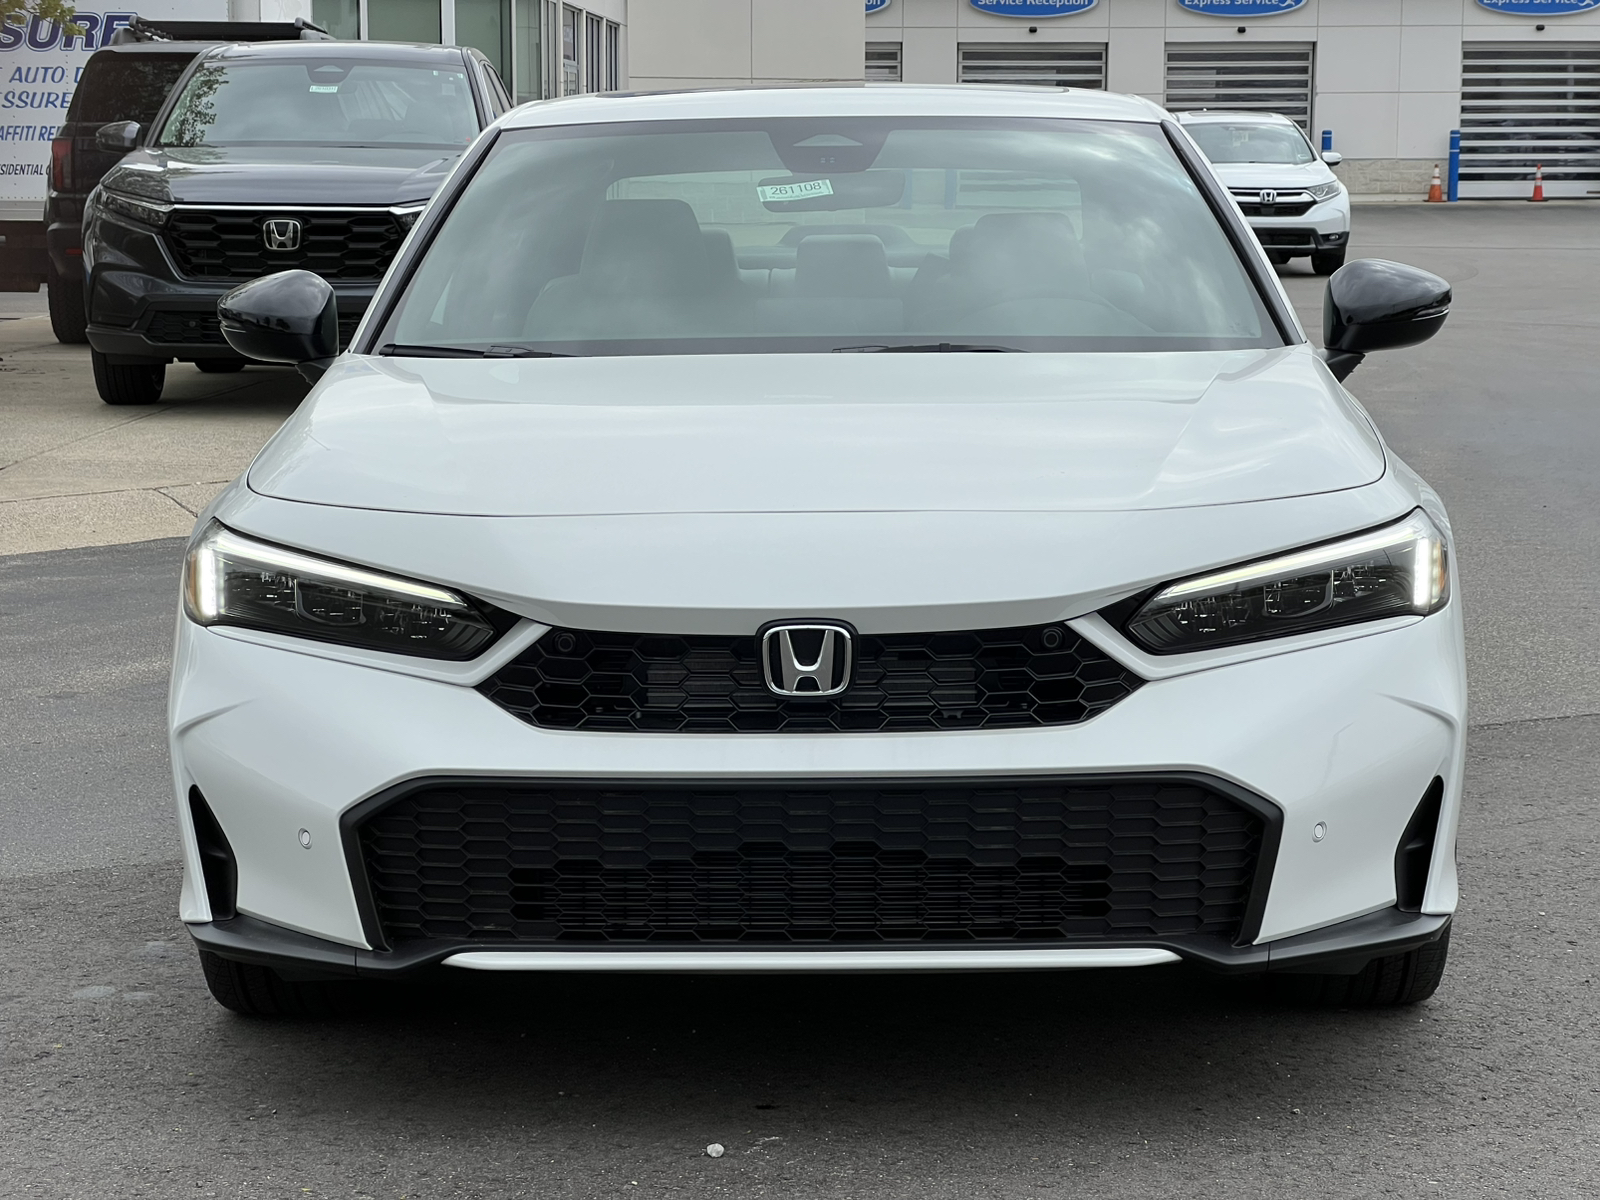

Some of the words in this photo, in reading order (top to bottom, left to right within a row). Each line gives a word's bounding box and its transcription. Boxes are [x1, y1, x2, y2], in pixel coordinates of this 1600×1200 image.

[9, 66, 66, 84] AUTO
[0, 90, 74, 109] SSURE
[0, 163, 44, 176] SIDENTIAL
[770, 182, 821, 195] 261108
